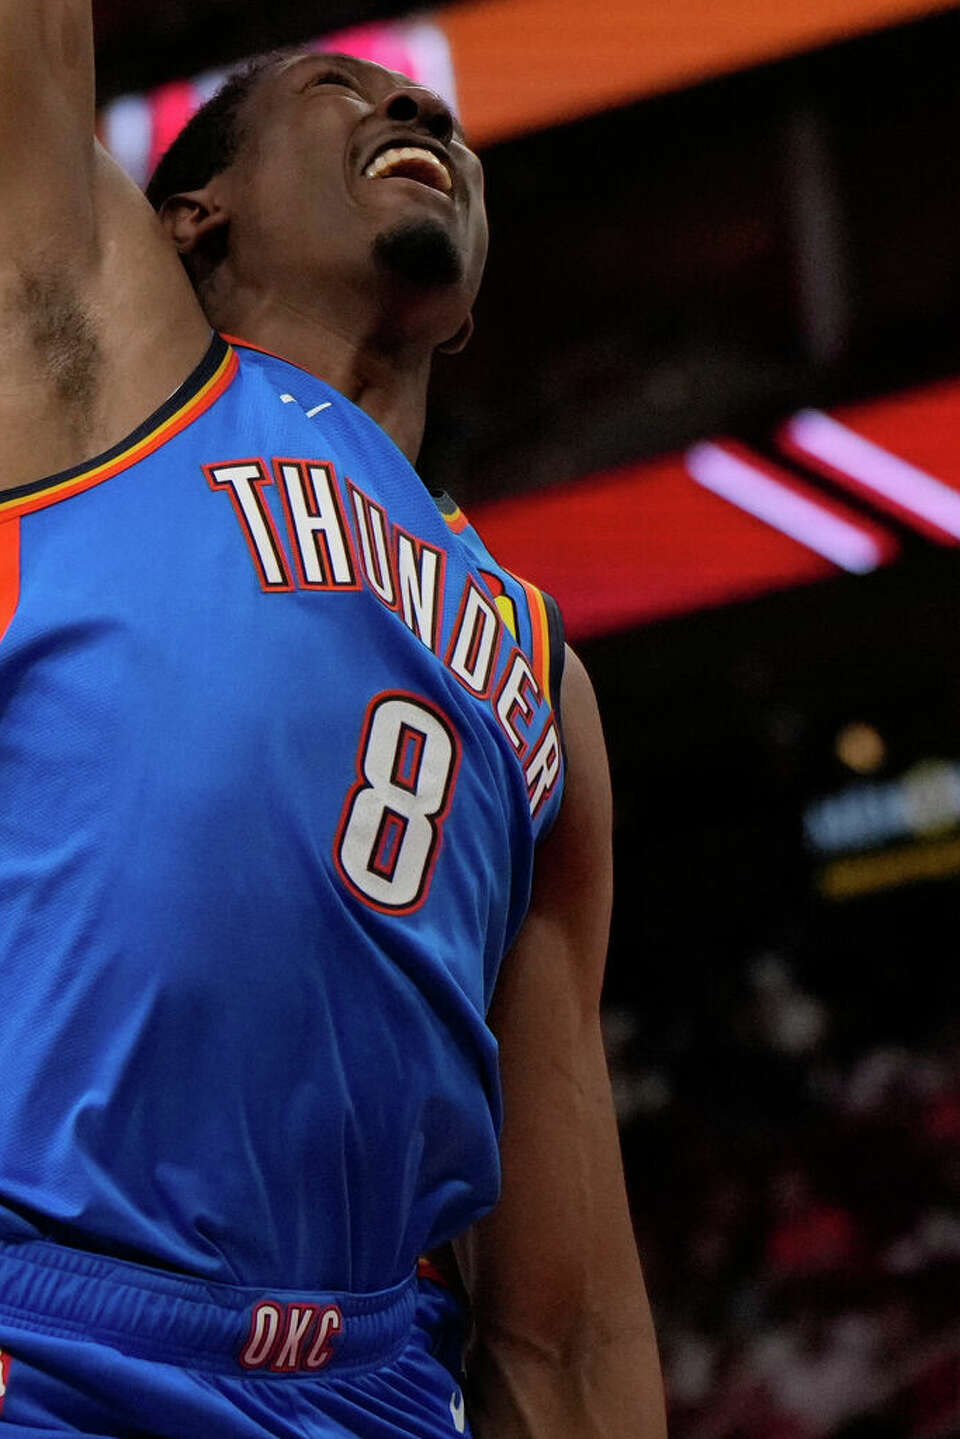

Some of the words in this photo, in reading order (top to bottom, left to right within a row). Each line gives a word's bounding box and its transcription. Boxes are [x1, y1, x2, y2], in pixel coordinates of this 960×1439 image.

[202, 457, 562, 820] THUNDER
[333, 689, 462, 916] 8
[240, 1300, 342, 1373] OKC
